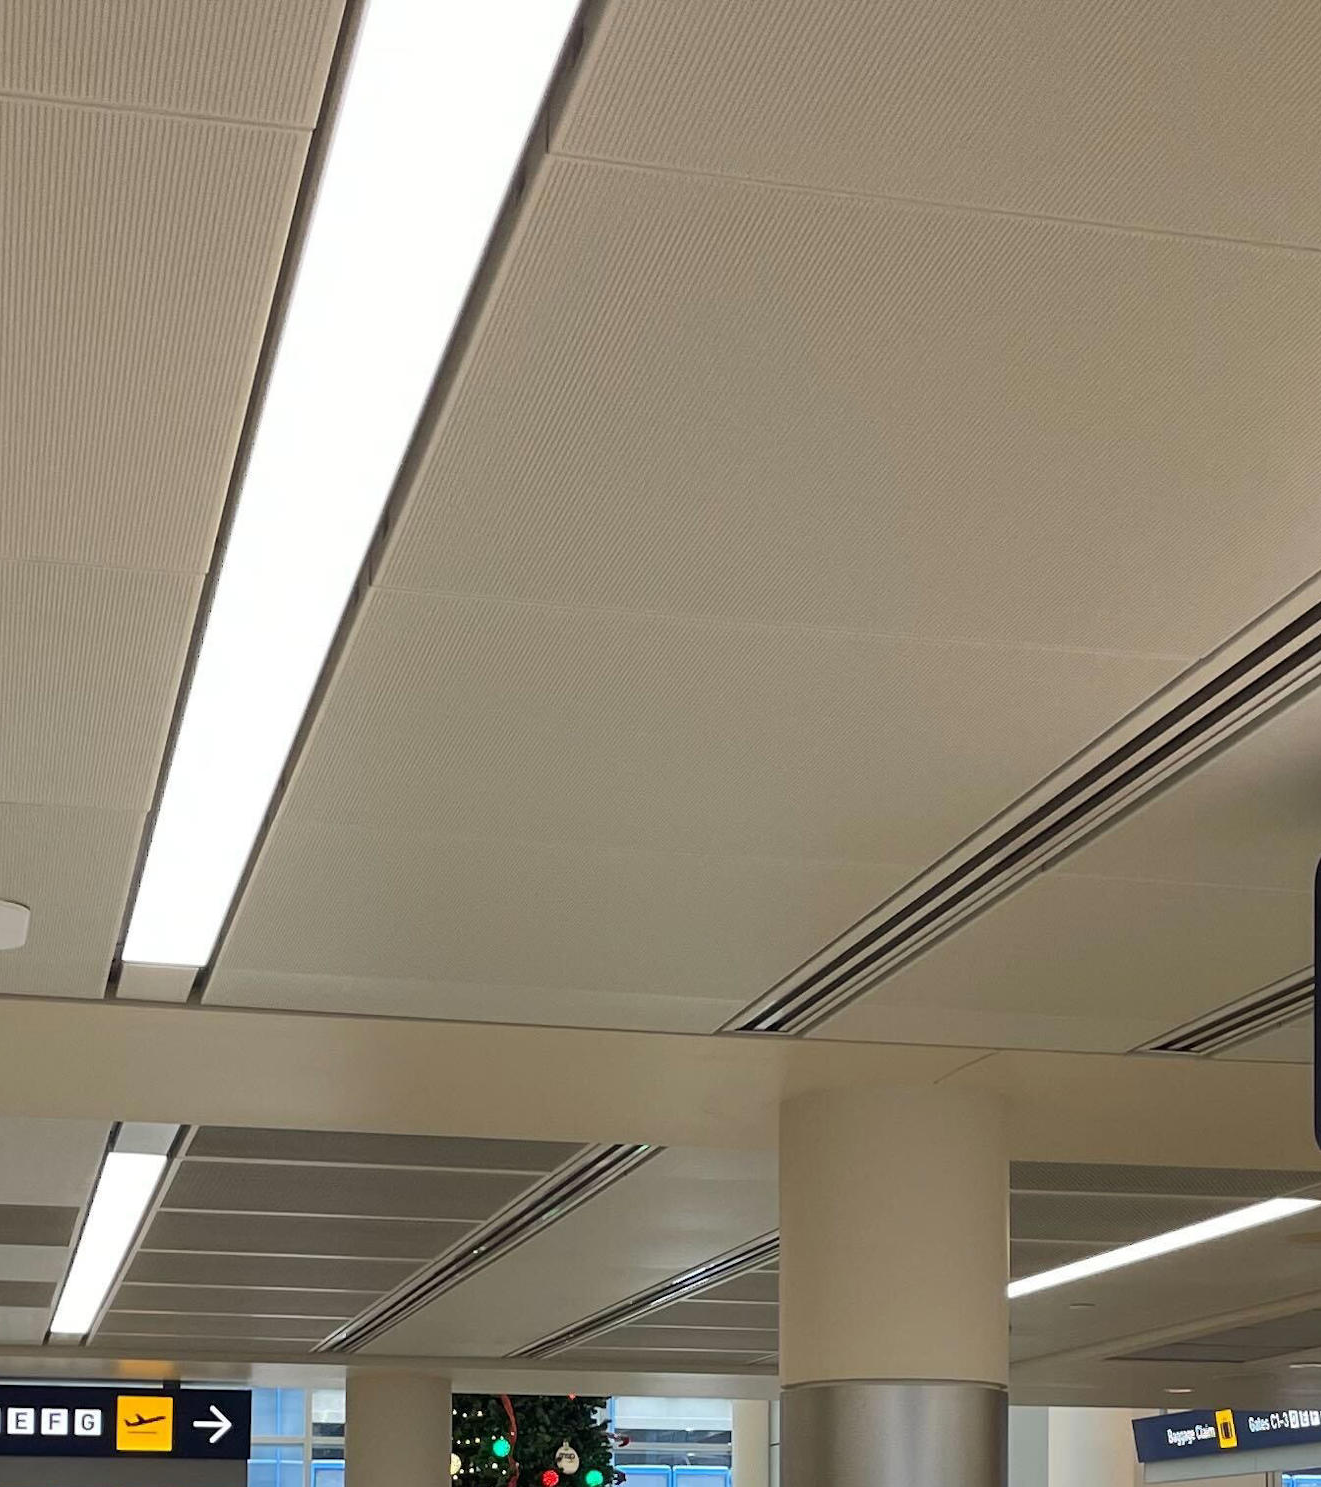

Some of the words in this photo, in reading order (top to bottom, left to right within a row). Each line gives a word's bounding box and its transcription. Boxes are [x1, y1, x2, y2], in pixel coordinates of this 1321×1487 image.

[10, 1410, 31, 1432] E
[44, 1411, 65, 1433] F
[78, 1411, 99, 1433] G
